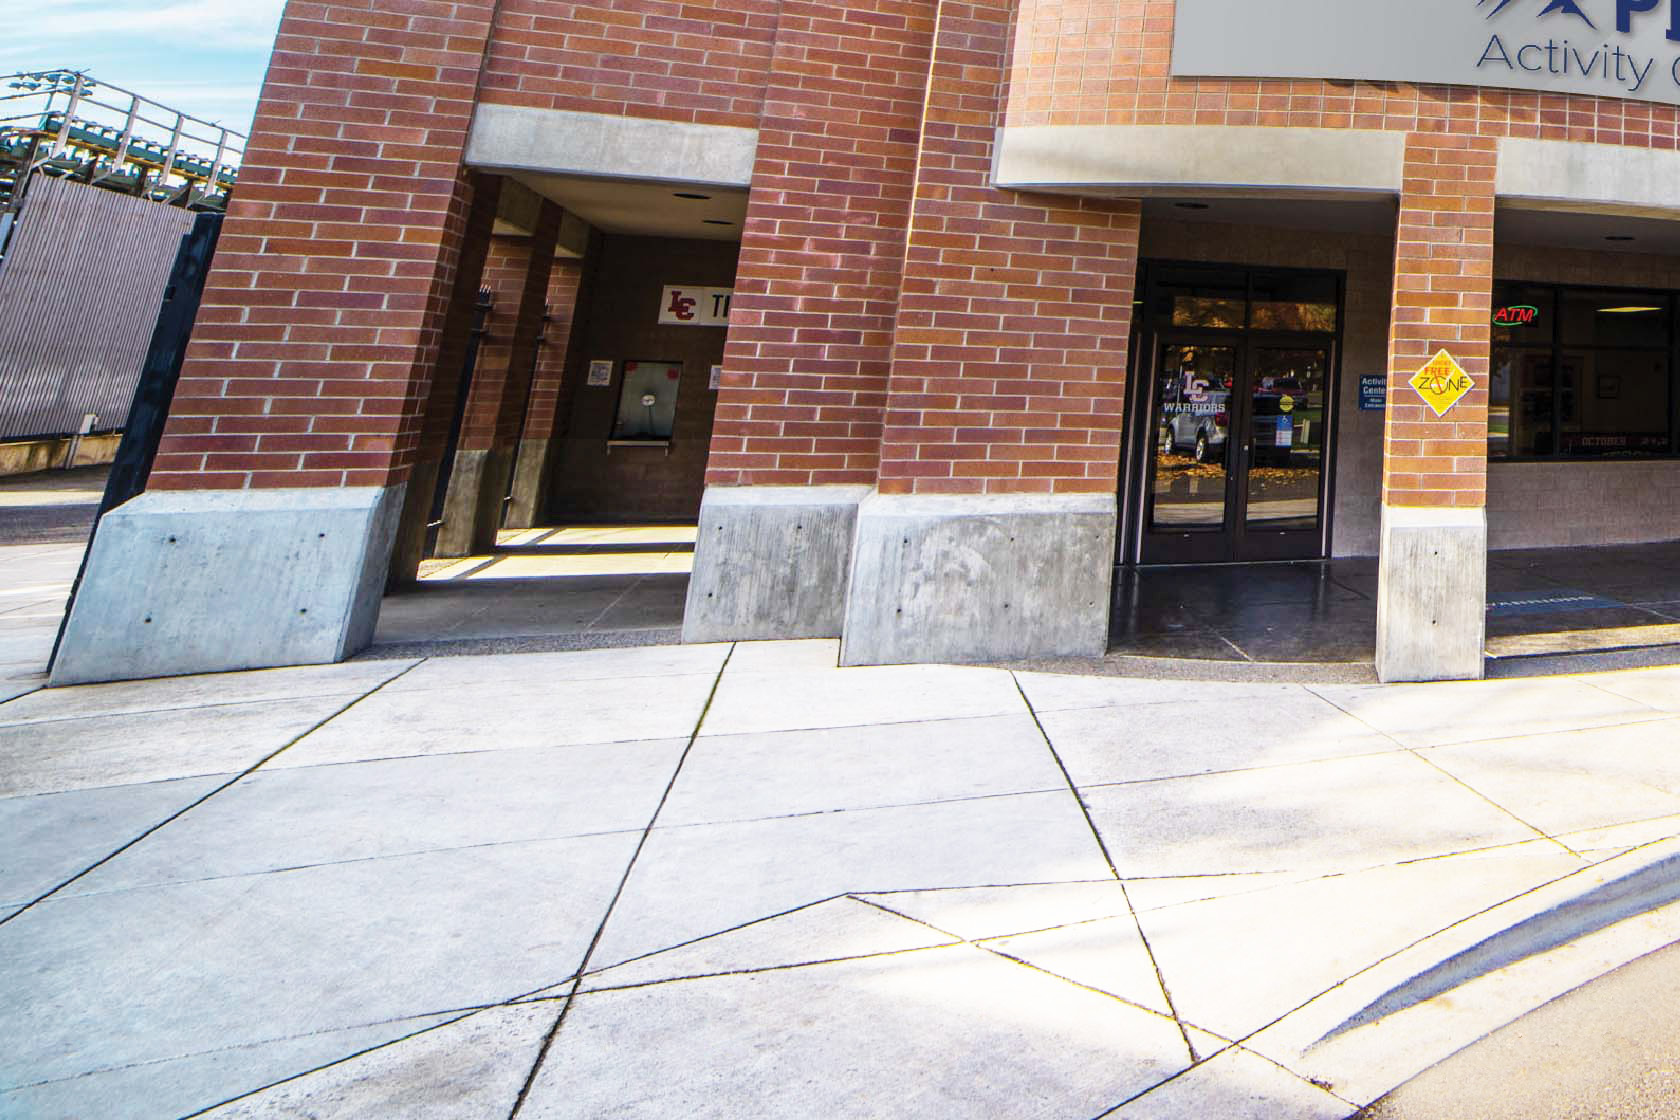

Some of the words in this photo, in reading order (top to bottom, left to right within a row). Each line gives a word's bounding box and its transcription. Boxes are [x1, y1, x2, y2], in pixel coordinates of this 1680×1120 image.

[1476, 34, 1654, 91] Activity
[1494, 307, 1534, 322] ATM
[1362, 377, 1386, 385] Activit
[1418, 376, 1468, 395] ZONE
[1363, 386, 1386, 394] Cente
[1163, 402, 1226, 413] WARRIORS
